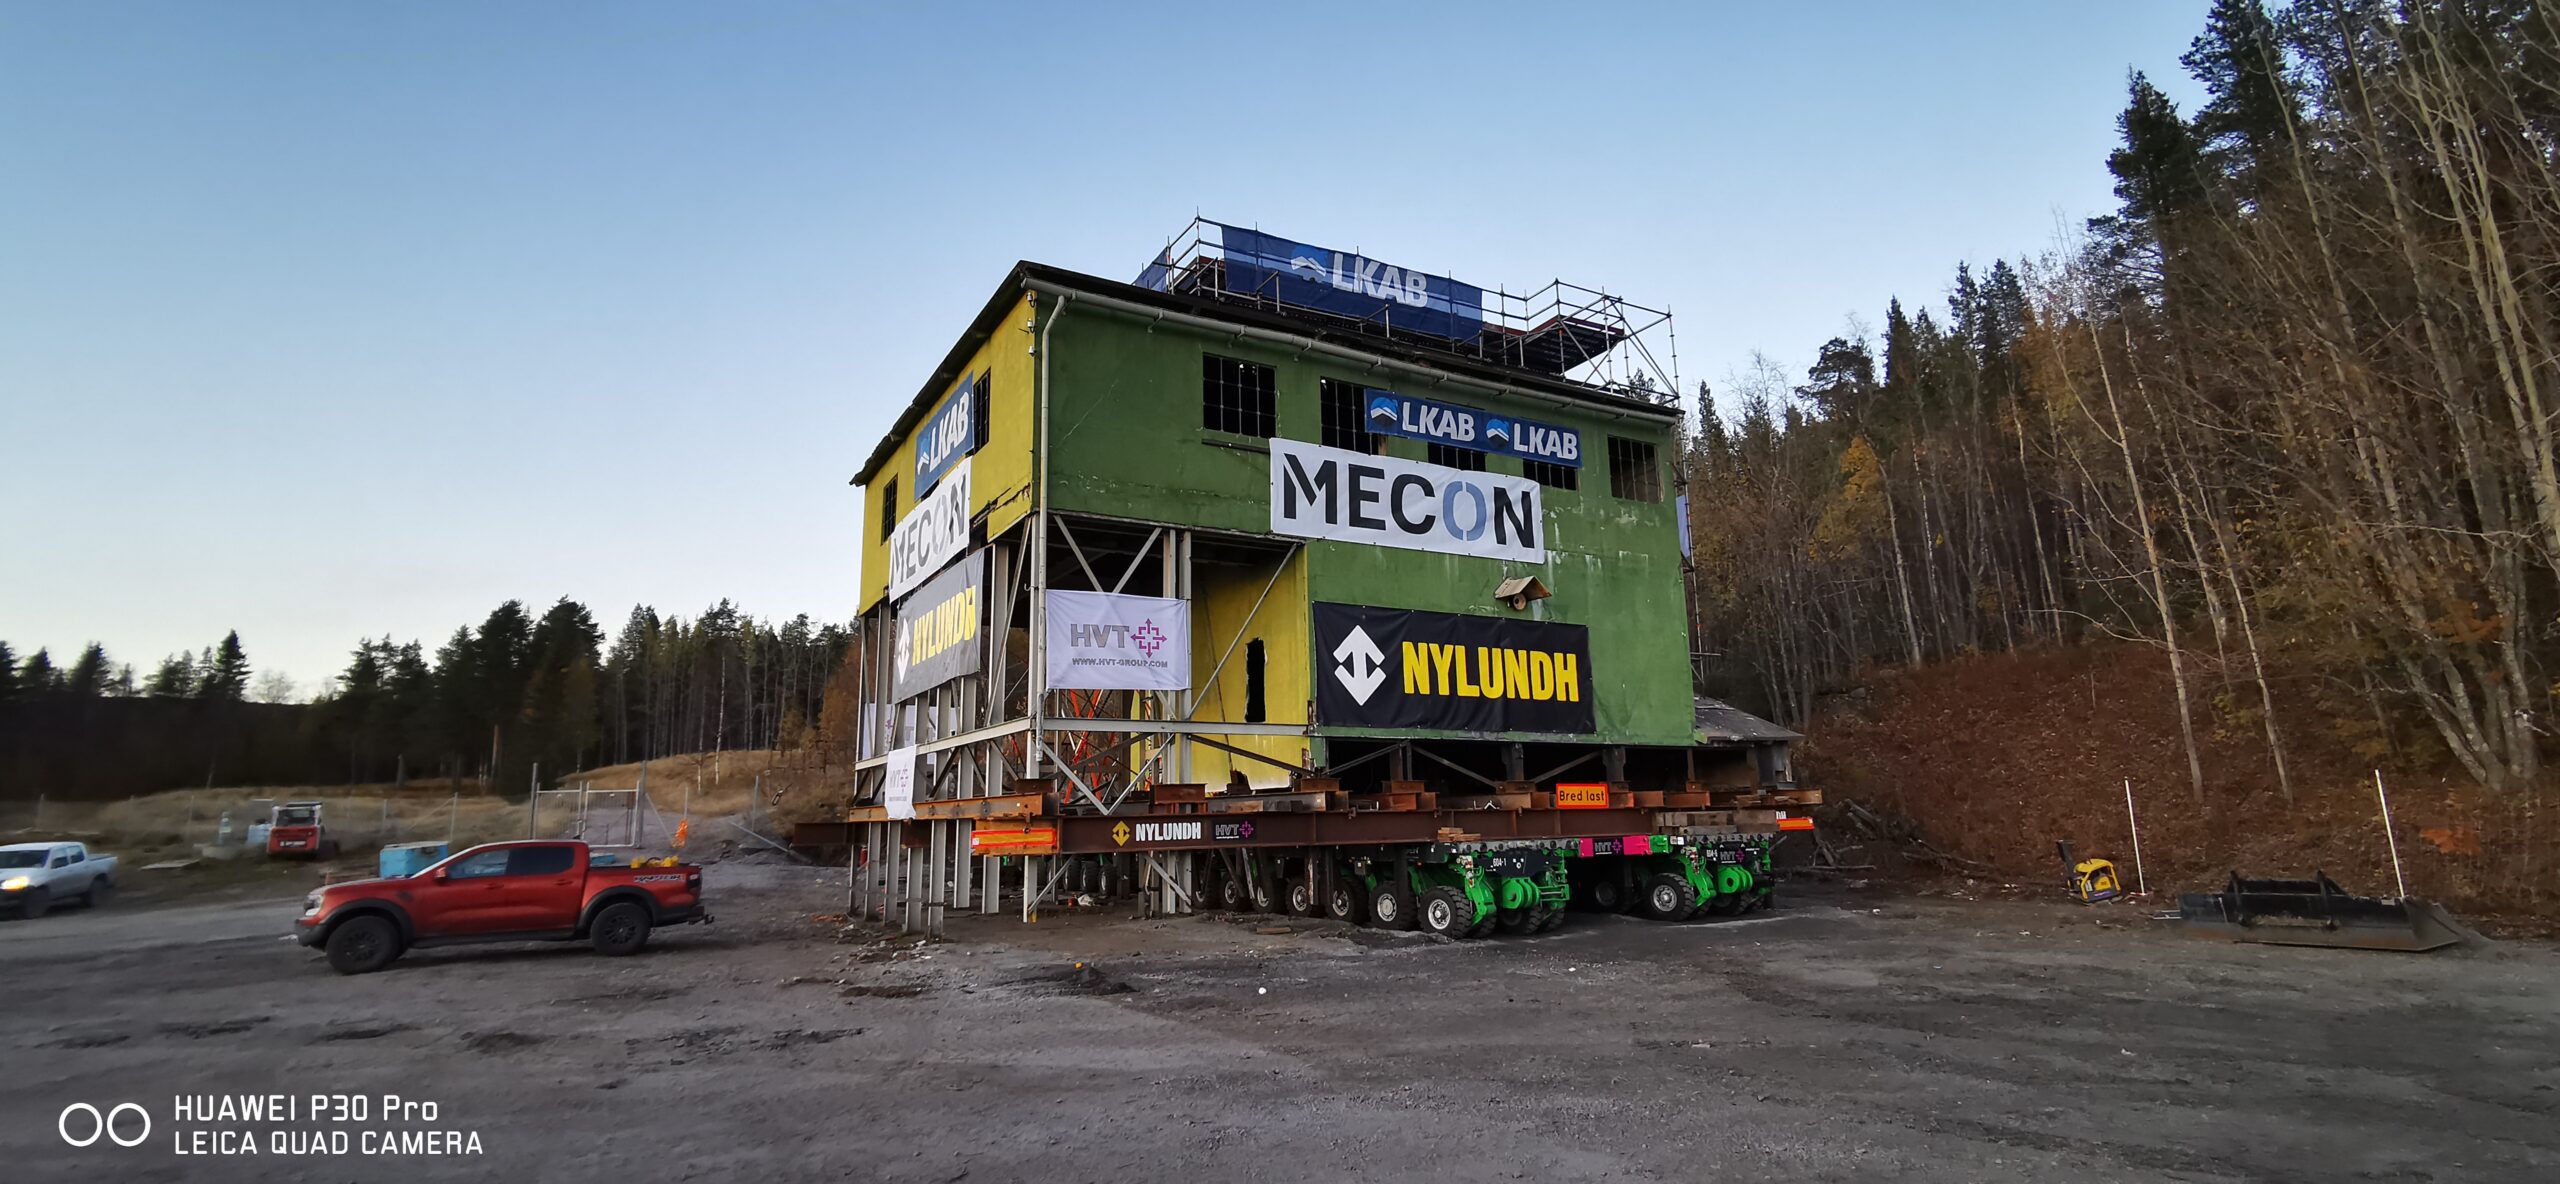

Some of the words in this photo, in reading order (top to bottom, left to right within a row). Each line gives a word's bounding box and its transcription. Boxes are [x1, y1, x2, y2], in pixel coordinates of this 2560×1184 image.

[1332, 251, 1428, 308] LKAB
[929, 391, 970, 473] LKAB
[1402, 401, 1475, 442] LKAB
[1513, 423, 1578, 460] LKAB
[1283, 452, 1535, 549] MECON
[890, 473, 967, 590] MECON
[911, 584, 977, 667] NYLUNDH
[1070, 623, 1130, 648] HVT
[1072, 657, 1168, 668] WWW.HVT-GROUP.COM
[1402, 641, 1580, 702] NYLUNDH
[1559, 790, 1583, 801] Bred
[1586, 790, 1605, 801] last
[1135, 822, 1202, 842] NYLUNDH
[1215, 824, 1240, 836] HVT
